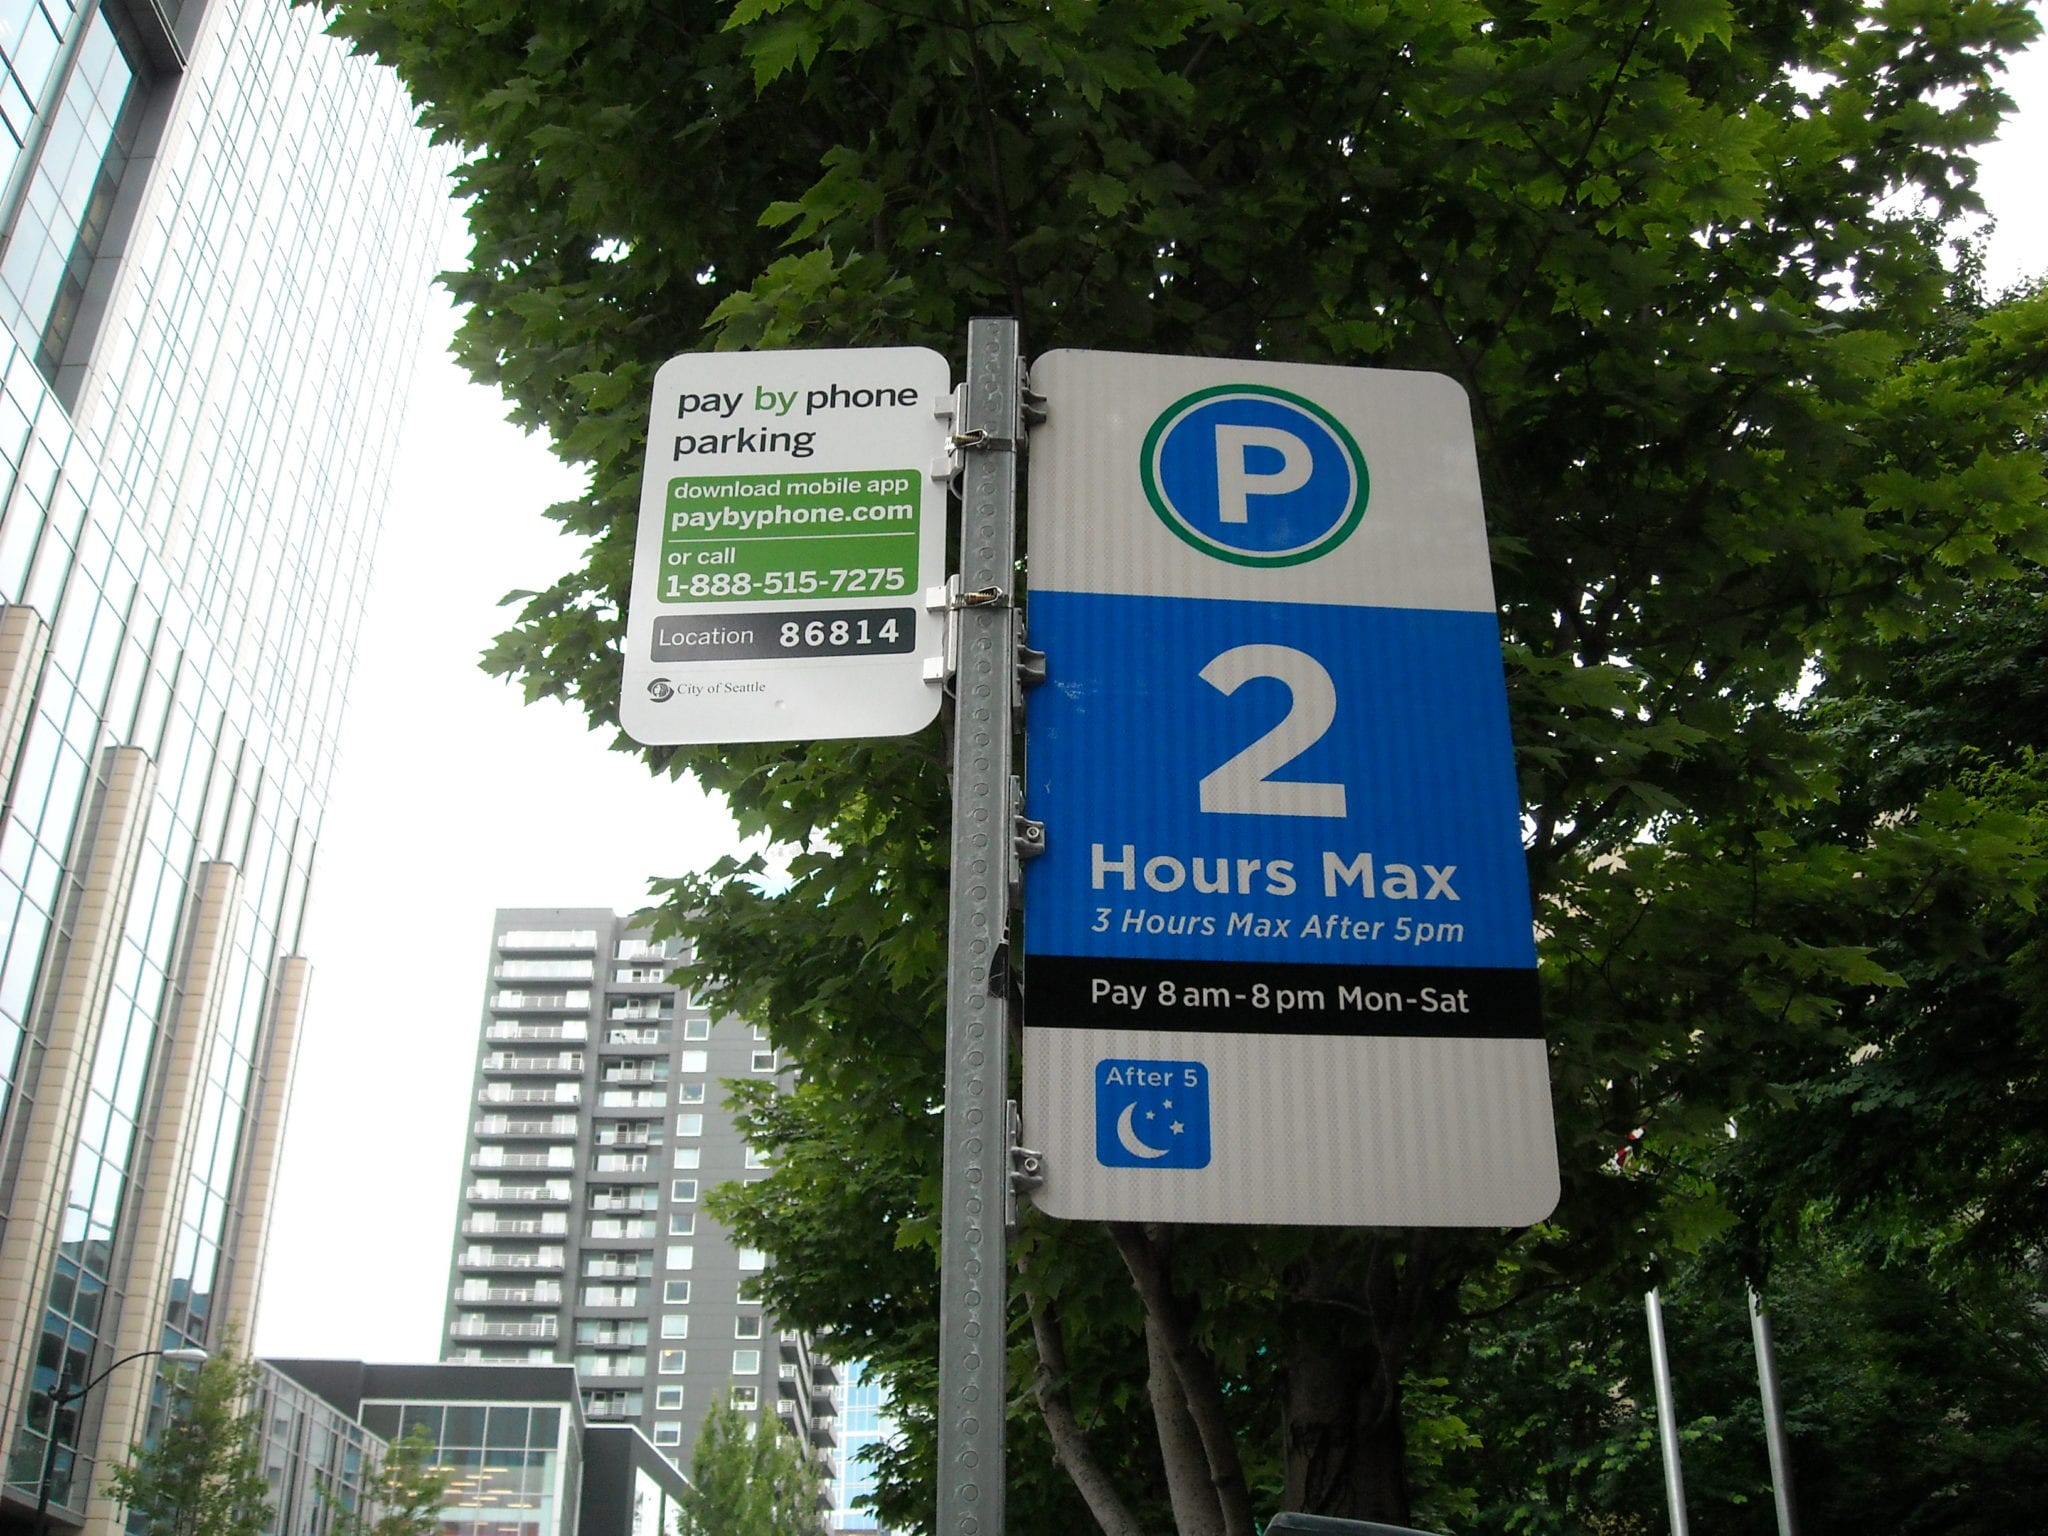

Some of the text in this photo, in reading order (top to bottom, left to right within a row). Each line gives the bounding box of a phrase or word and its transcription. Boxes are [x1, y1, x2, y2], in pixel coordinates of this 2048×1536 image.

[678, 384, 918, 418] pay by phone
[673, 427, 816, 460] parking
[674, 478, 909, 499] download mobile app
[1215, 423, 1314, 523] P
[672, 504, 913, 532] paybyphone.com
[668, 547, 735, 565] or call
[666, 568, 904, 597] 1-888-515-7275
[659, 618, 899, 647] Location 86814
[677, 681, 766, 695] City of Seattle
[1198, 643, 1347, 818] 2
[1092, 843, 1461, 901] Hours Max
[1092, 908, 1464, 945] 3 Hours Max After 5pm
[1092, 979, 1147, 1010] Pay
[1339, 985, 1469, 1013] Mon-Sat
[1105, 1066, 1198, 1087] After 5
